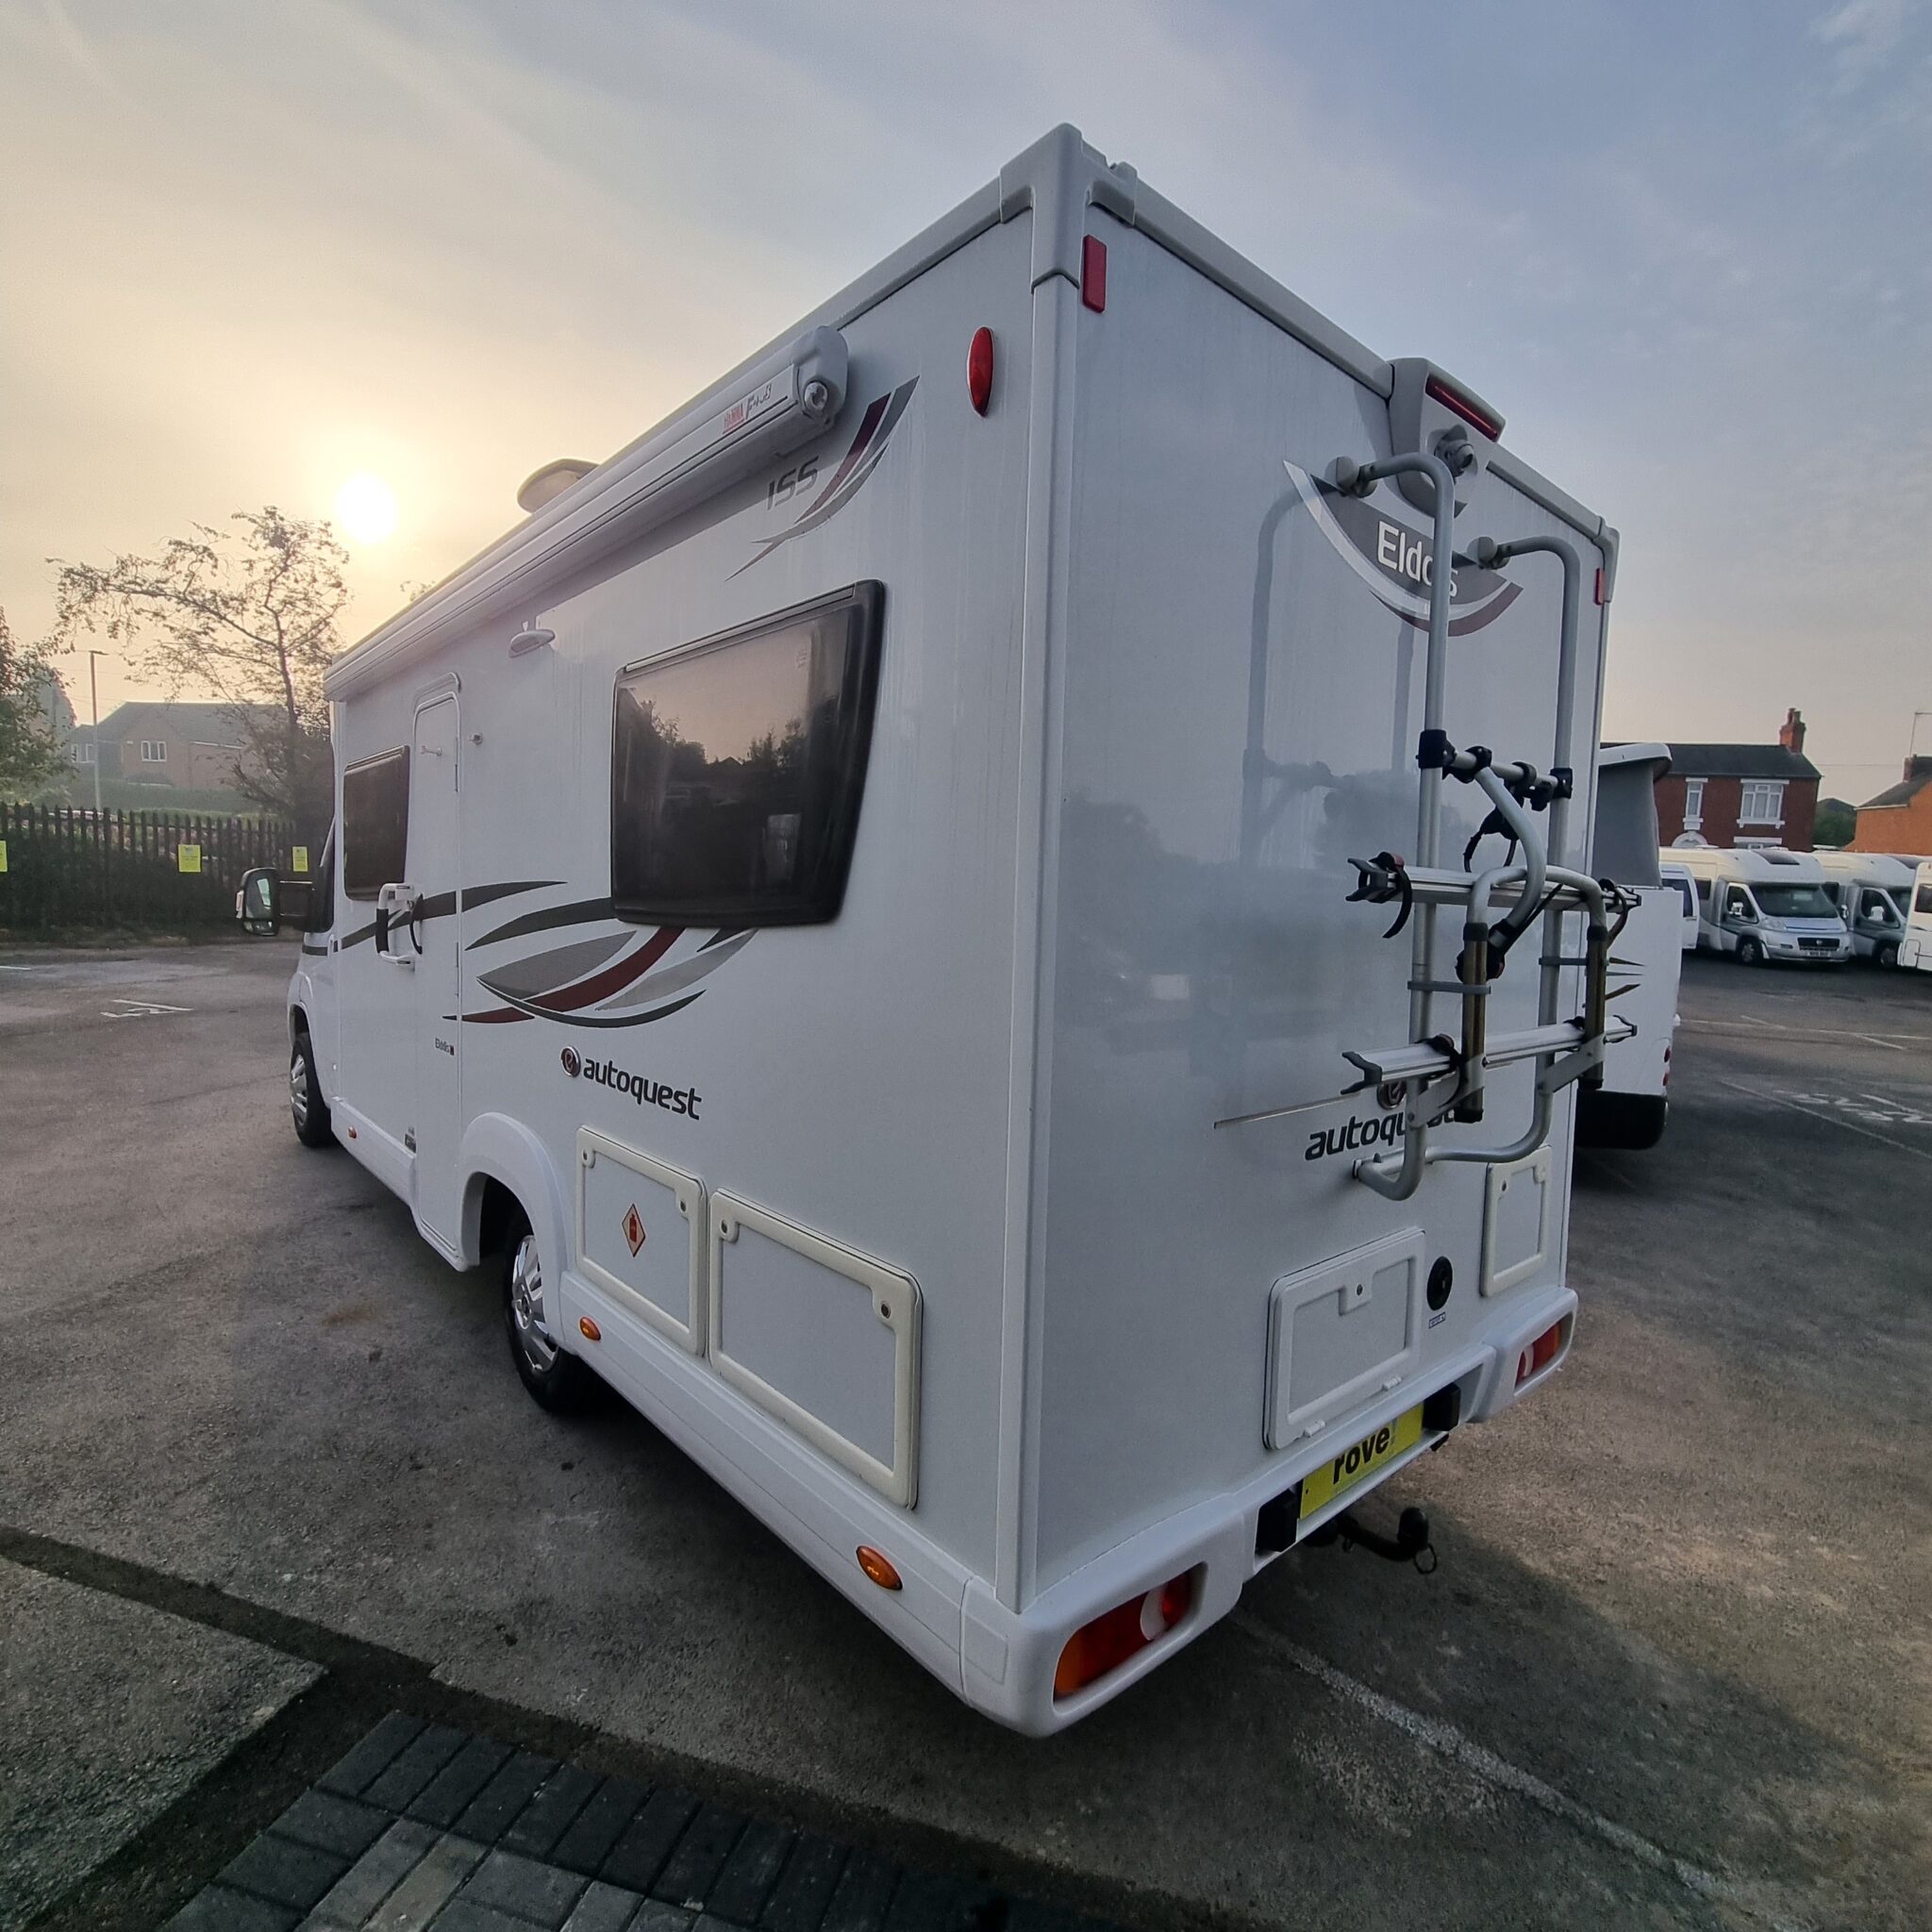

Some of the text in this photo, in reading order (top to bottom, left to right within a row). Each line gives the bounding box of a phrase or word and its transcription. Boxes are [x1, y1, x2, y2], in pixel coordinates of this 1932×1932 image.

[1377, 520, 1458, 598] Elds
[582, 1058, 703, 1121] autoquest
[1304, 1109, 1456, 1161] autoq
